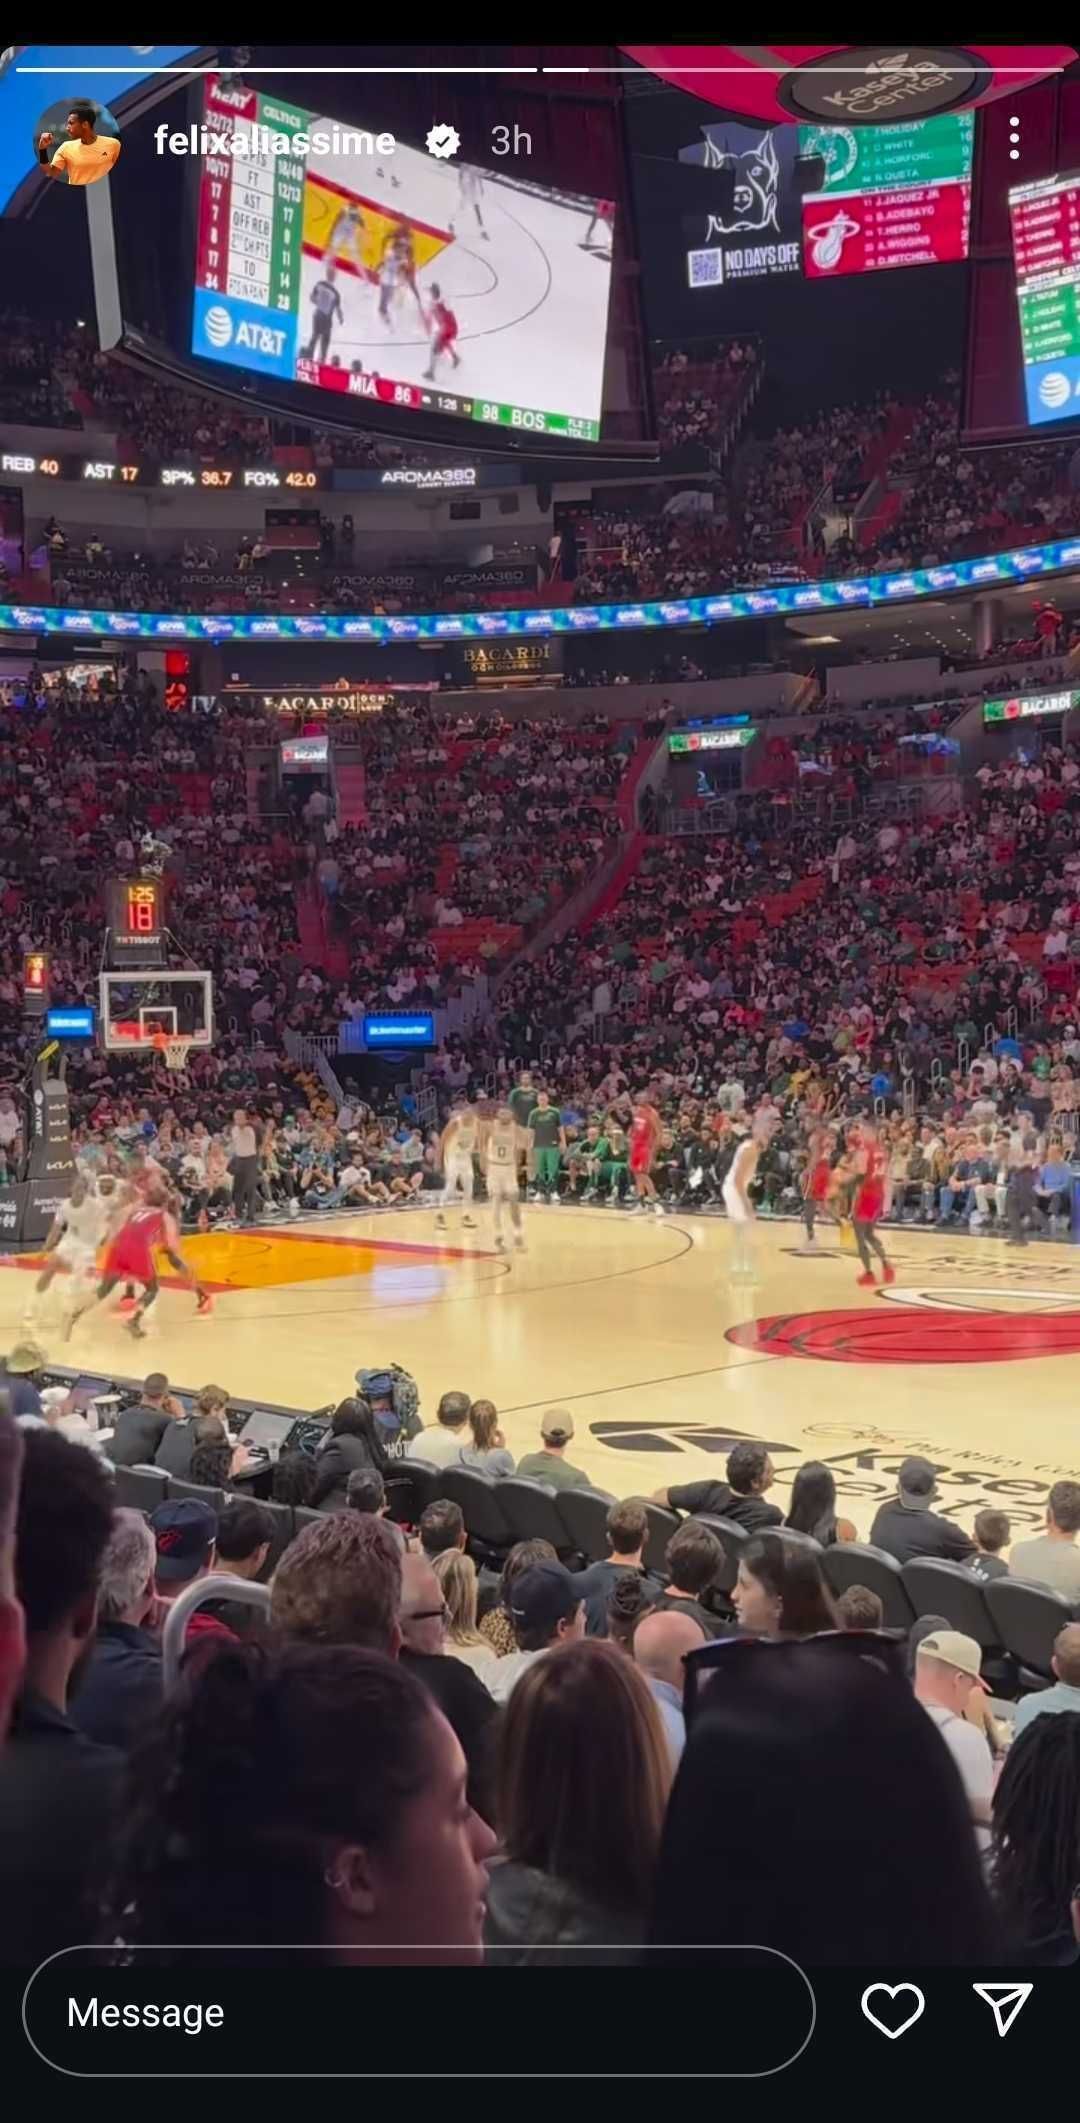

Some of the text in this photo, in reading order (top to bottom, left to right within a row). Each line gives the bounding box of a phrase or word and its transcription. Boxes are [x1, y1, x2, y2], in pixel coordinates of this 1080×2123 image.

[821, 60, 940, 106] Kaseya
[847, 69, 953, 114] Center
[248, 170, 259, 186] FT
[211, 182, 222, 199] 17
[244, 192, 261, 209] AST
[233, 211, 250, 229] OFF
[250, 216, 270, 236] REB
[283, 207, 294, 223] 17
[244, 260, 256, 277] TO
[725, 242, 800, 270] NO DAYS OFF
[235, 320, 287, 357] AT&T
[349, 375, 378, 398] MIA
[394, 386, 411, 403] 86
[482, 404, 545, 430] 98 BOS
[2, 455, 317, 487] REB 40 AST 17 3P% 36.7 FG% 42.0
[381, 468, 476, 484] AROMA360
[128, 887, 154, 902] 1:25
[129, 903, 153, 930] 18
[128, 936, 160, 944] TISSOT
[46, 1160, 74, 1171] KIA
